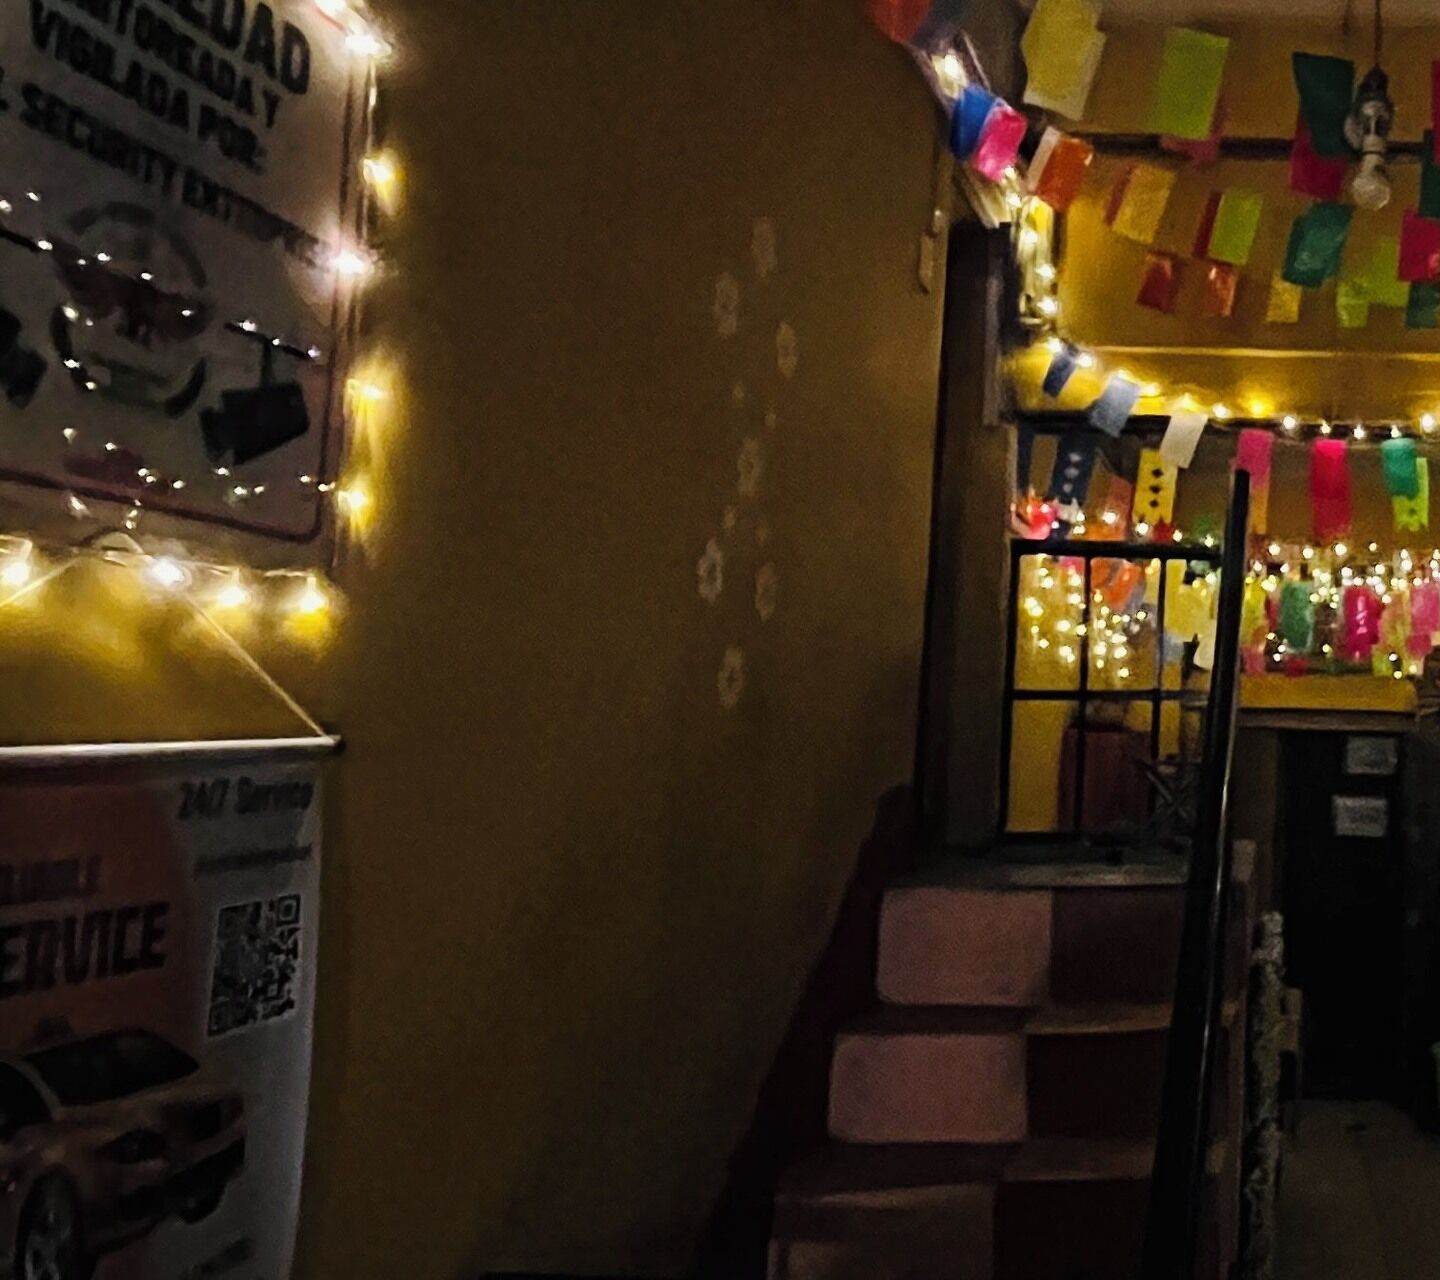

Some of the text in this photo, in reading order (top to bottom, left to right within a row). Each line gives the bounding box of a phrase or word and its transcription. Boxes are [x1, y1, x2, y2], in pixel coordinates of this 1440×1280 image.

[29, 0, 190, 132] VIGILADA
[262, 89, 281, 130] Y
[20, 82, 178, 197] SECURITY
